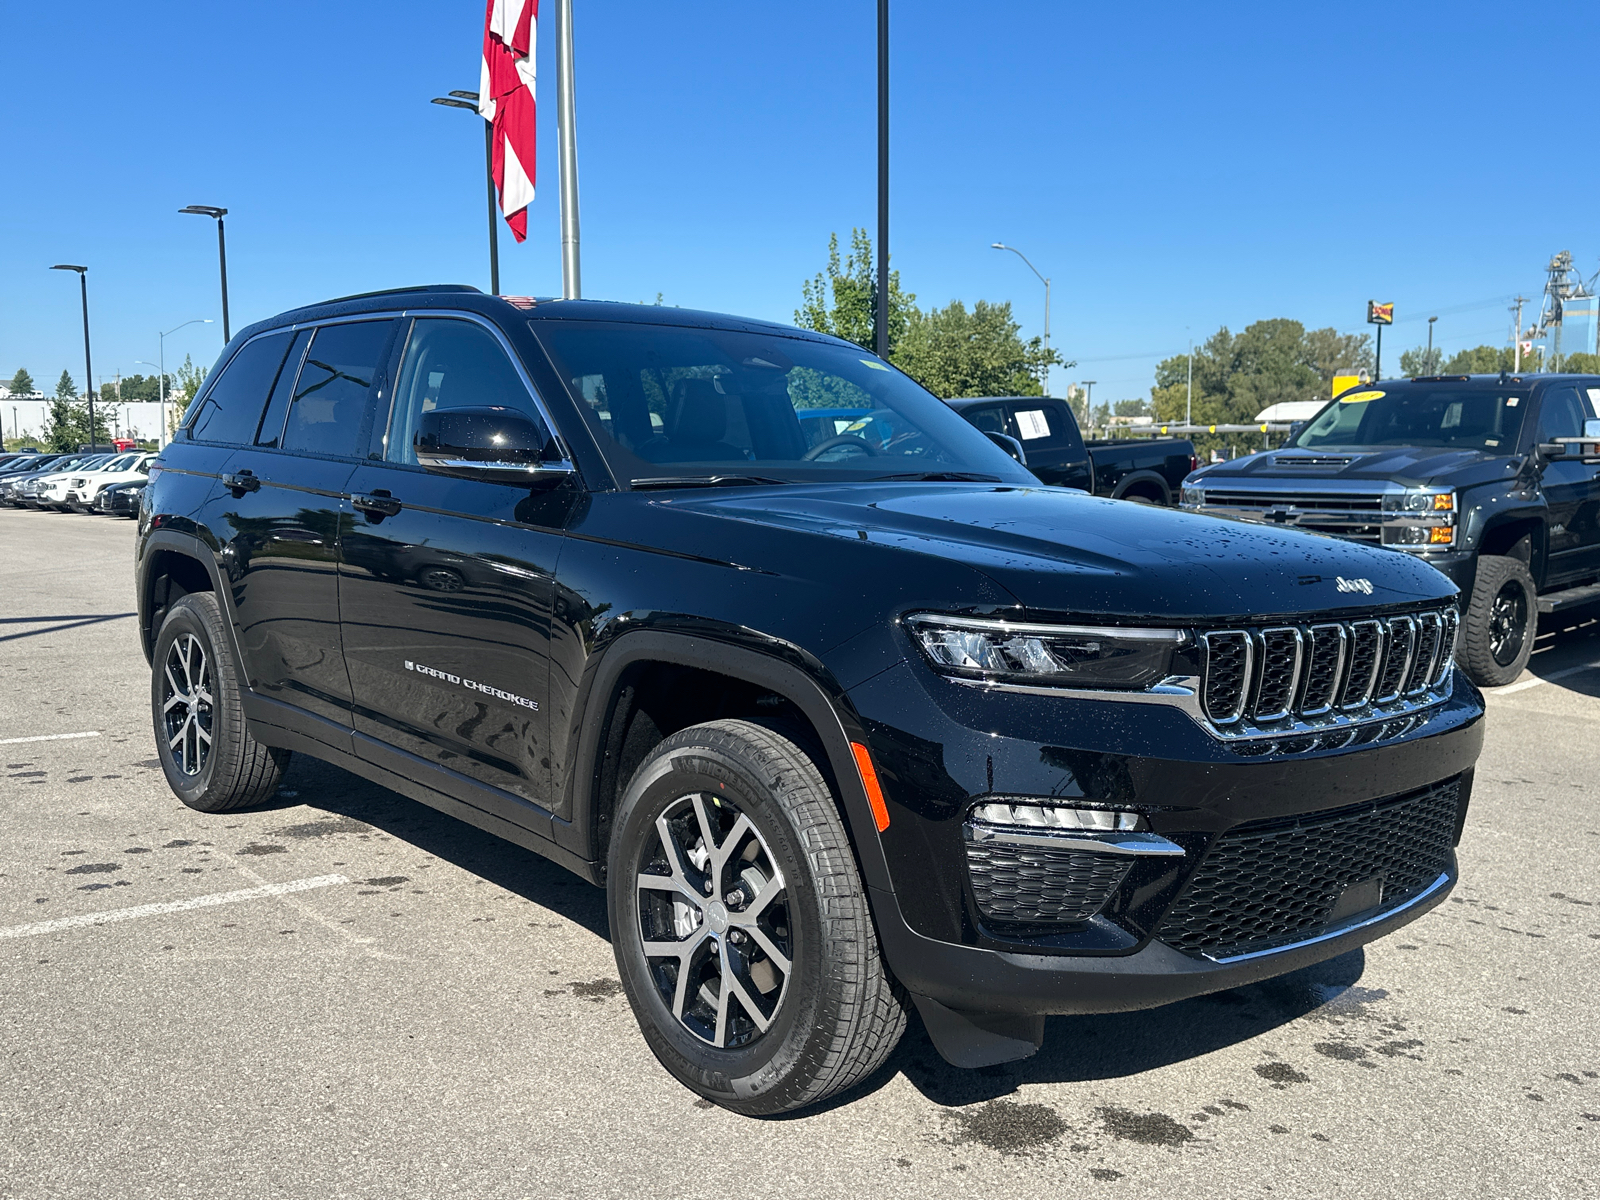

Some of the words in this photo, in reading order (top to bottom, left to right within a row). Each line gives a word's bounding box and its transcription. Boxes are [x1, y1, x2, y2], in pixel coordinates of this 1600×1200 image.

[1335, 576, 1374, 595] Jeep
[416, 664, 460, 685] GRAND
[463, 679, 539, 711] CHEROKEE
[698, 759, 759, 805] MICHELIN
